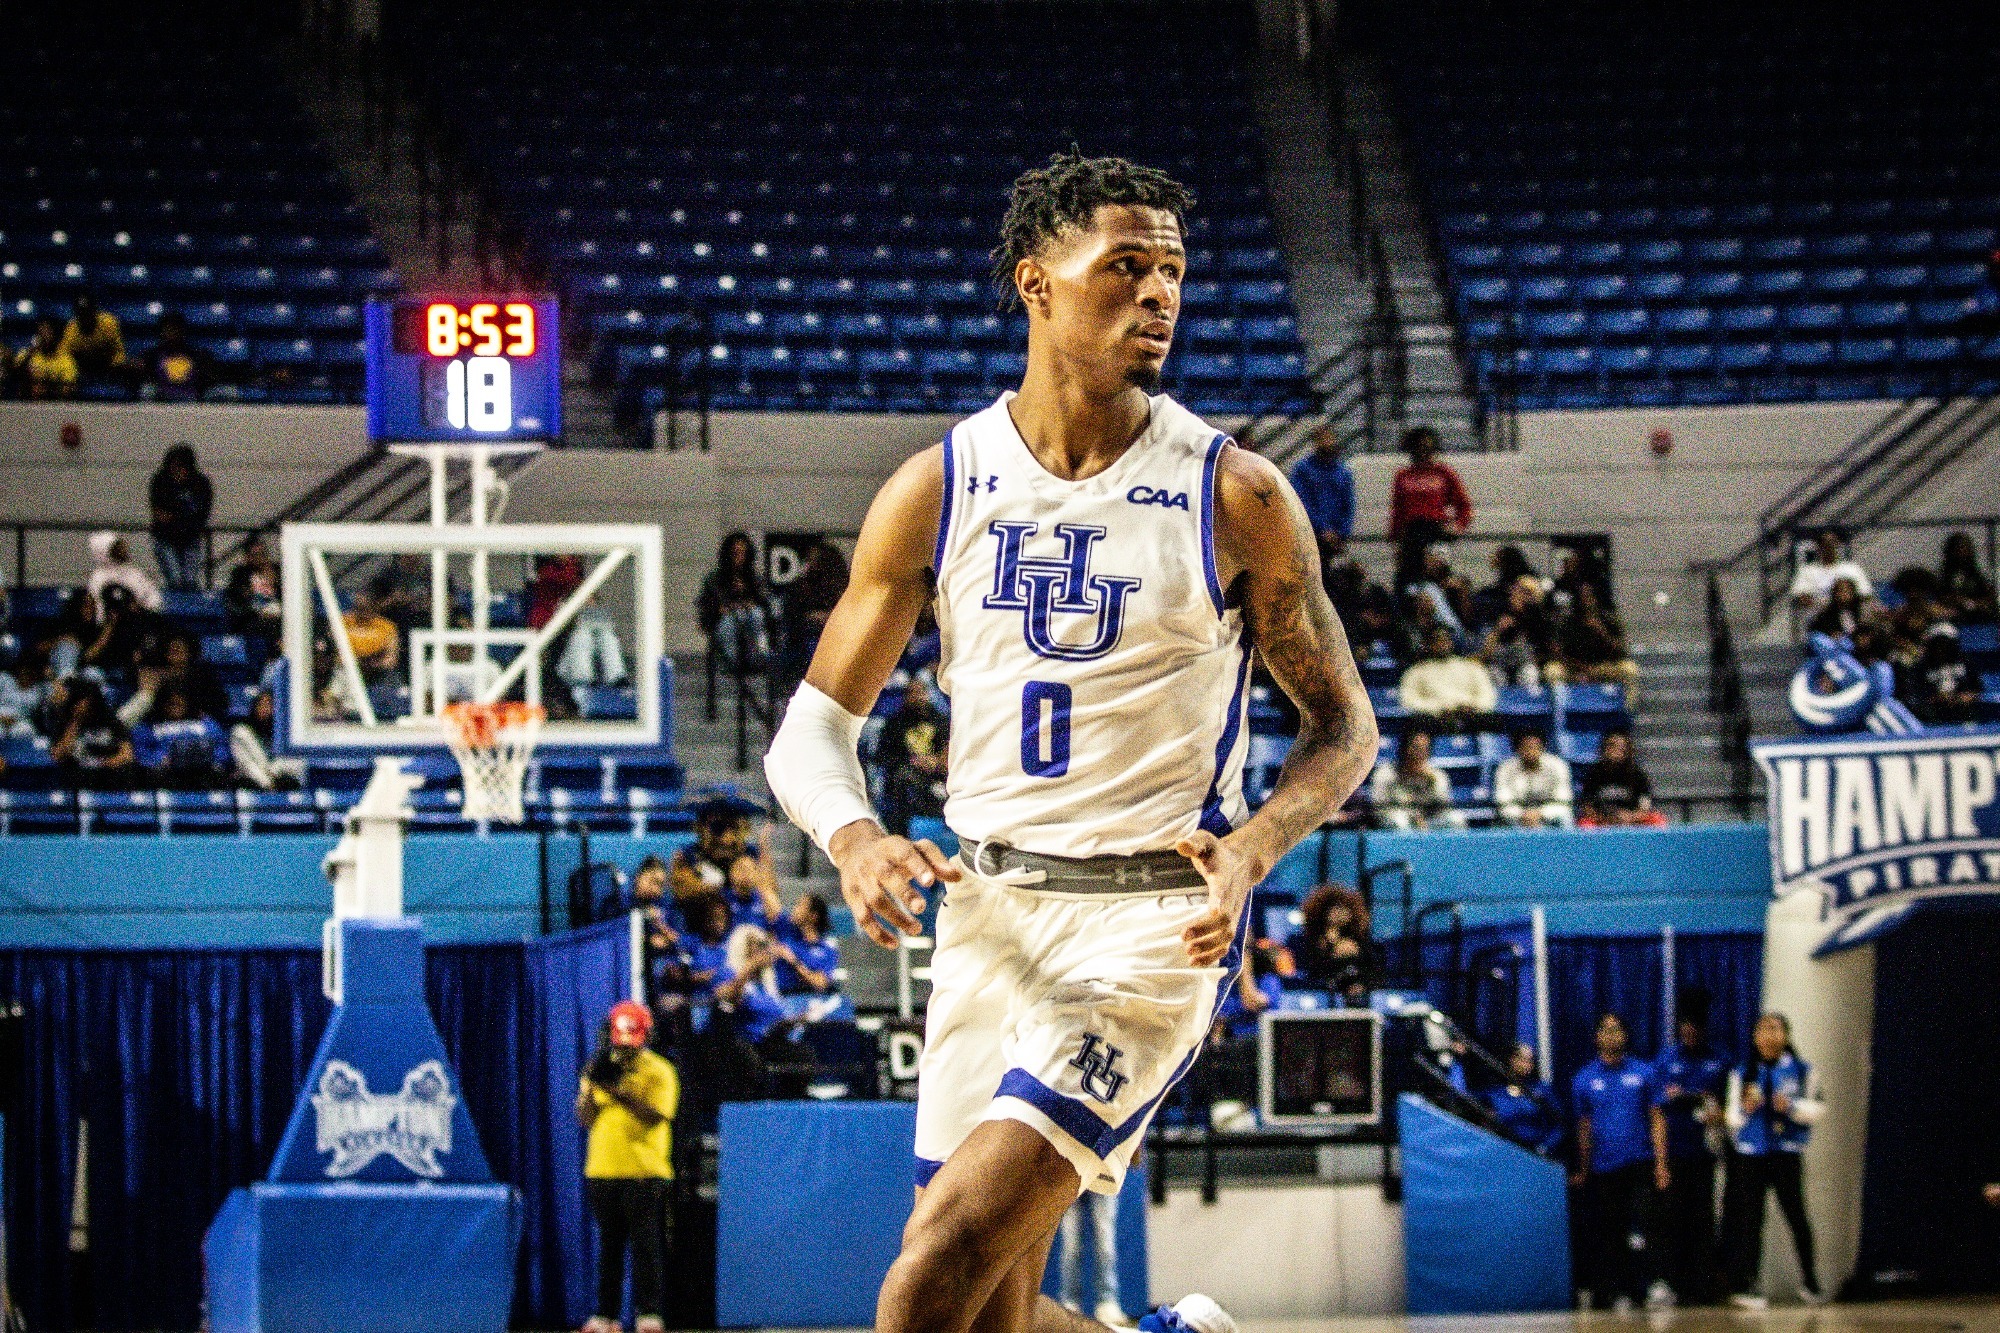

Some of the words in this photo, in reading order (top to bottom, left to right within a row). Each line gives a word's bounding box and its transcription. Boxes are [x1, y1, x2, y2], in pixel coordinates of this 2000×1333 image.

[427, 303, 535, 357] 8:53
[446, 357, 512, 432] 18
[1126, 485, 1190, 511] CAA
[982, 520, 1142, 662] HU
[1020, 680, 1072, 778] 0
[1777, 750, 2000, 876] HAMP
[1069, 1031, 1130, 1104] HU
